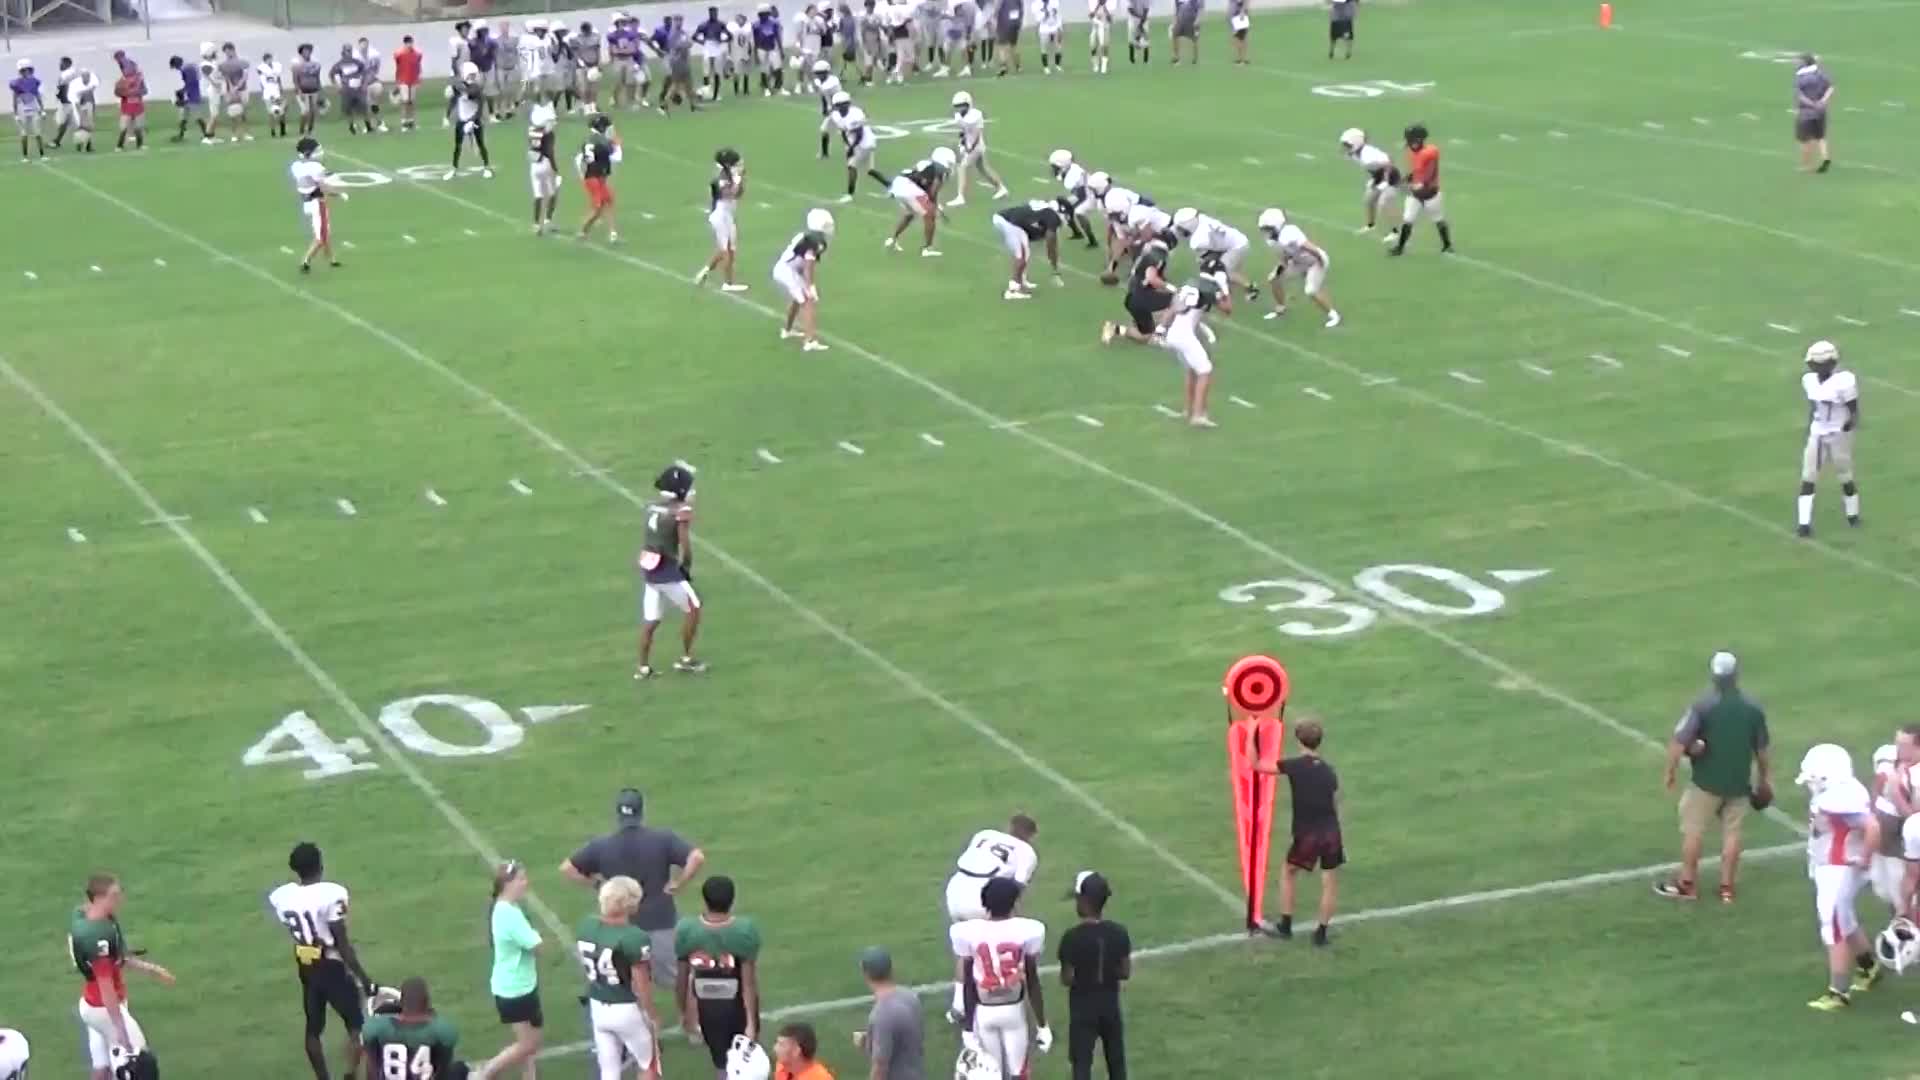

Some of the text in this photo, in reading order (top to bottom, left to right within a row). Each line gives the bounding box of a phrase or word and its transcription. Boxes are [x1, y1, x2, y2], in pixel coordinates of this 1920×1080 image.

[1219, 563, 1505, 636] 30
[243, 693, 524, 779] 40
[577, 940, 621, 985] 54
[383, 1043, 434, 1080] 84
